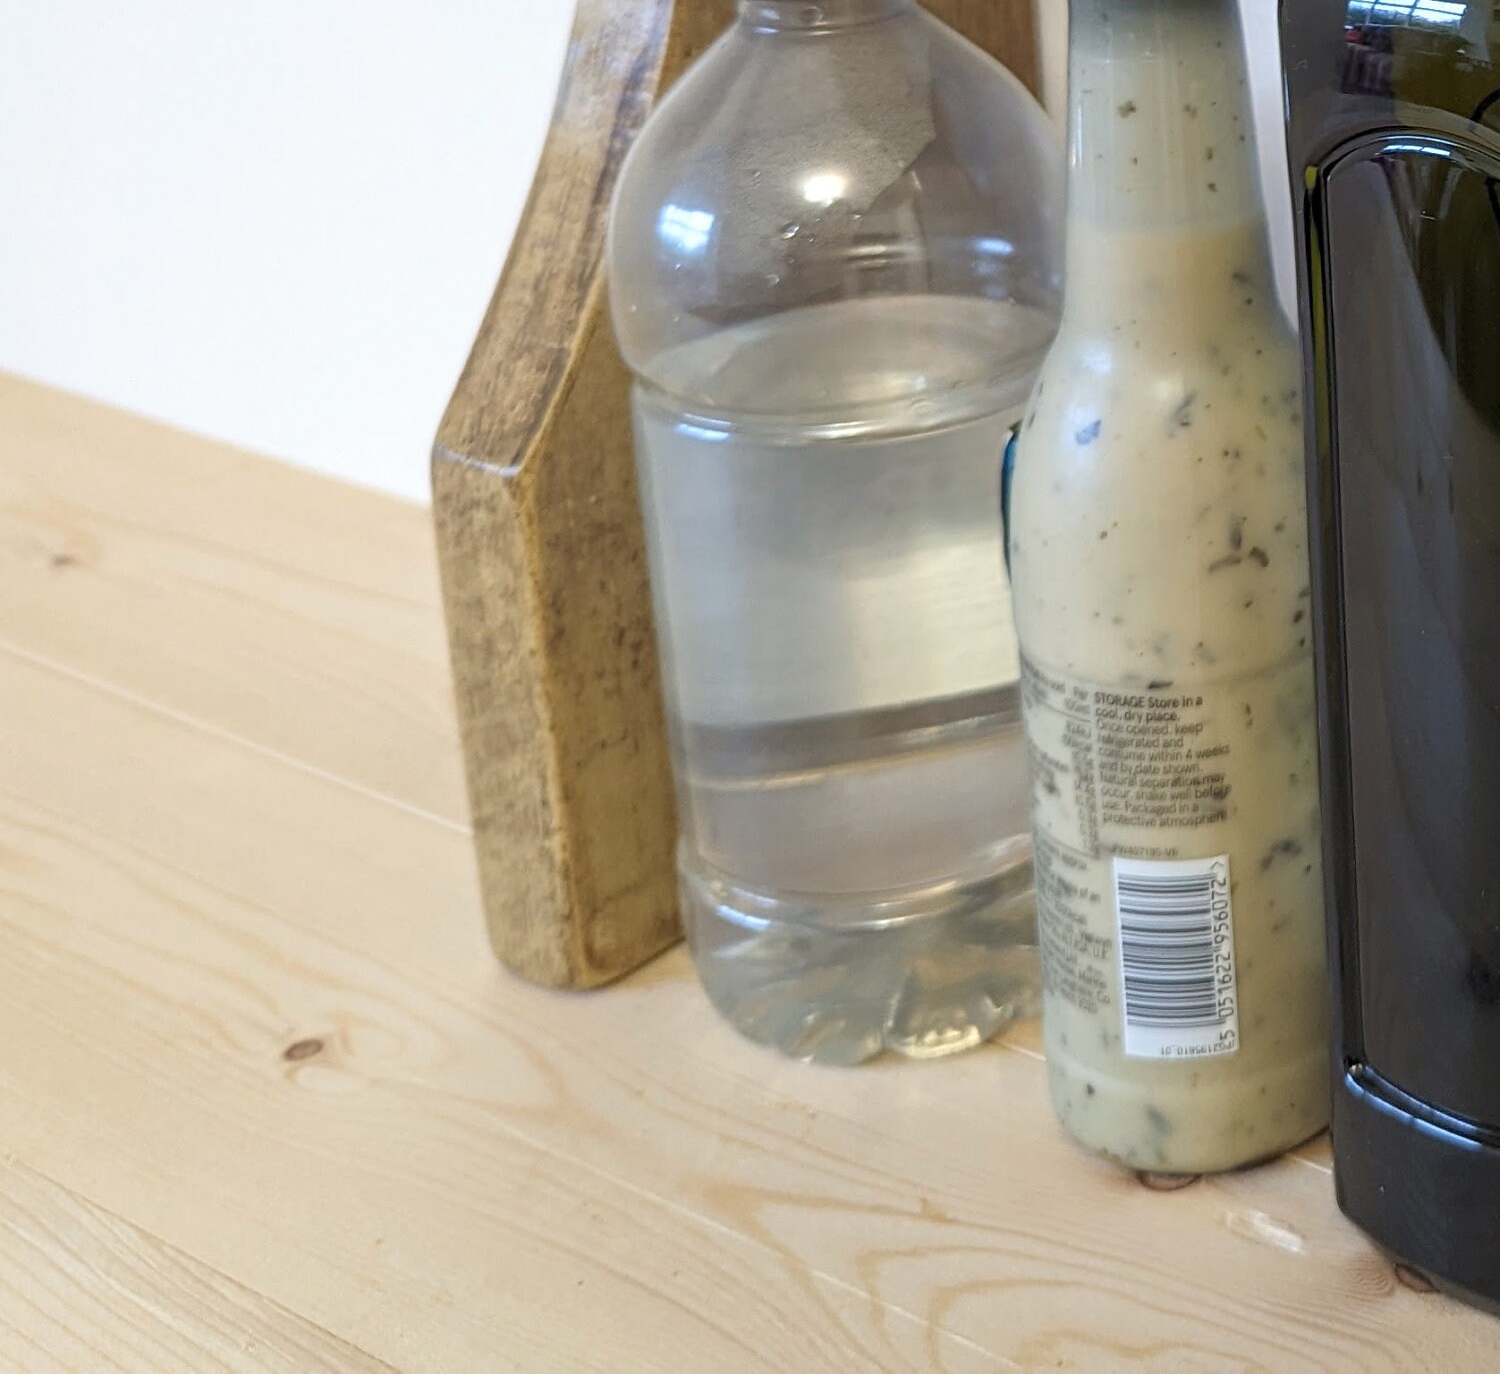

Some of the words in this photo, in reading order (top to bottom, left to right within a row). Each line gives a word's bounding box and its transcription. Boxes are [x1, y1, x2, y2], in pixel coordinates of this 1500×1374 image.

[1094, 691, 1146, 707] STORAGE
[1147, 696, 1180, 709] Store
[1182, 694, 1194, 708] in
[1195, 695, 1204, 706] a
[1124, 710, 1143, 724] dry
[1174, 722, 1204, 736] keep
[1162, 736, 1185, 748] and
[1148, 749, 1183, 762] within
[1185, 749, 1193, 760] 4
[1195, 744, 1231, 760] weeks
[1134, 762, 1160, 775] date
[1138, 775, 1201, 789] separation
[1202, 771, 1226, 785] may
[1169, 789, 1191, 800] well
[1124, 800, 1178, 816] Packaged
[1178, 801, 1190, 813] in
[1191, 802, 1200, 813] a
[1210, 876, 1230, 946] 956072
[1215, 951, 1235, 1019] 051622
[1218, 1028, 1236, 1042] 5
